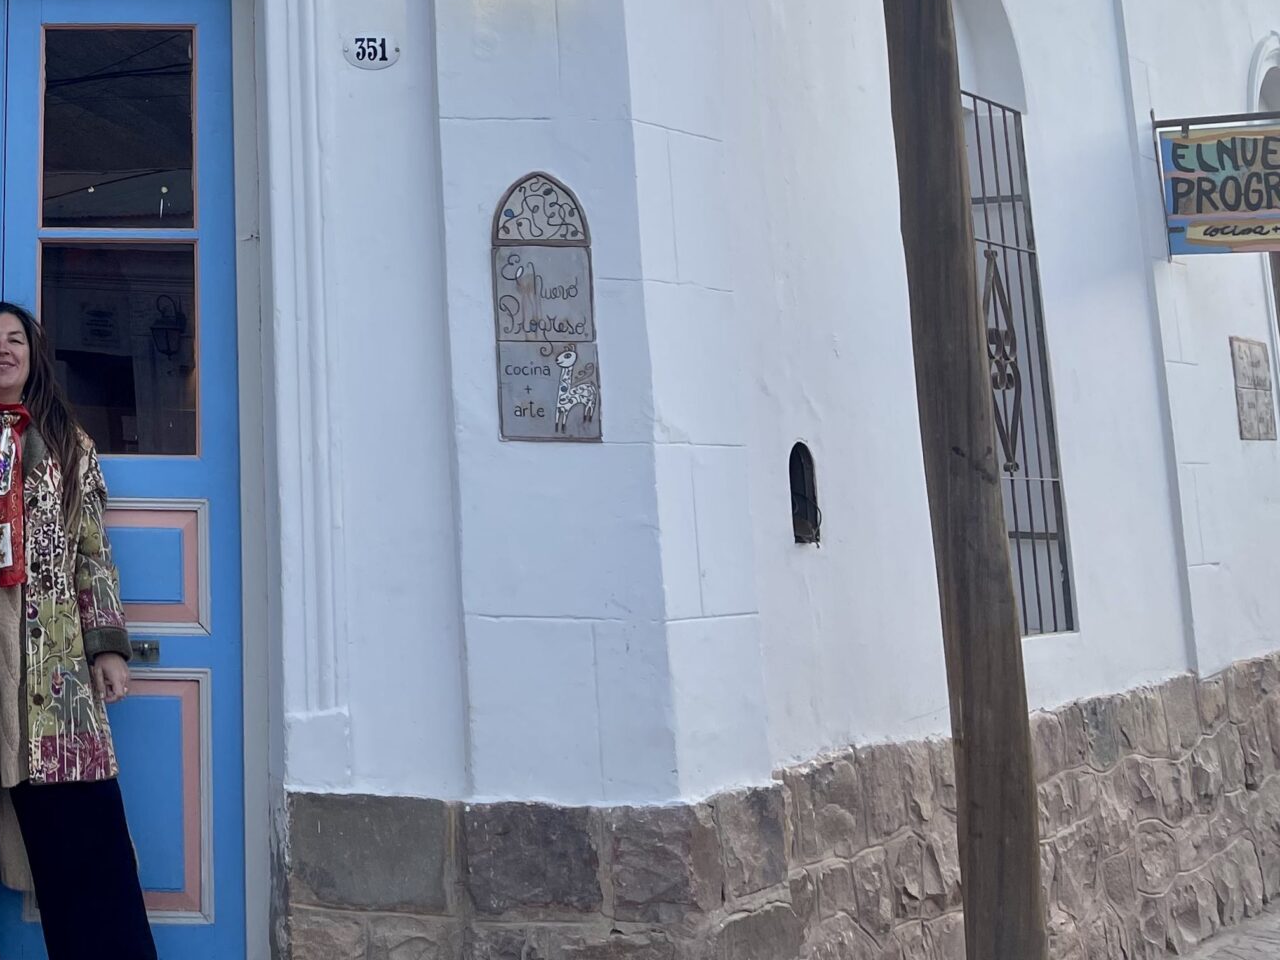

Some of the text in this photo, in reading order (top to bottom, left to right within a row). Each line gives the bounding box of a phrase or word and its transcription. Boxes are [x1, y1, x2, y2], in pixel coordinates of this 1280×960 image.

[354, 37, 388, 61] 351
[1171, 136, 1280, 173] EL NUE
[1171, 171, 1280, 215] PROGR
[504, 360, 551, 377] cocina
[513, 400, 546, 419] arte
